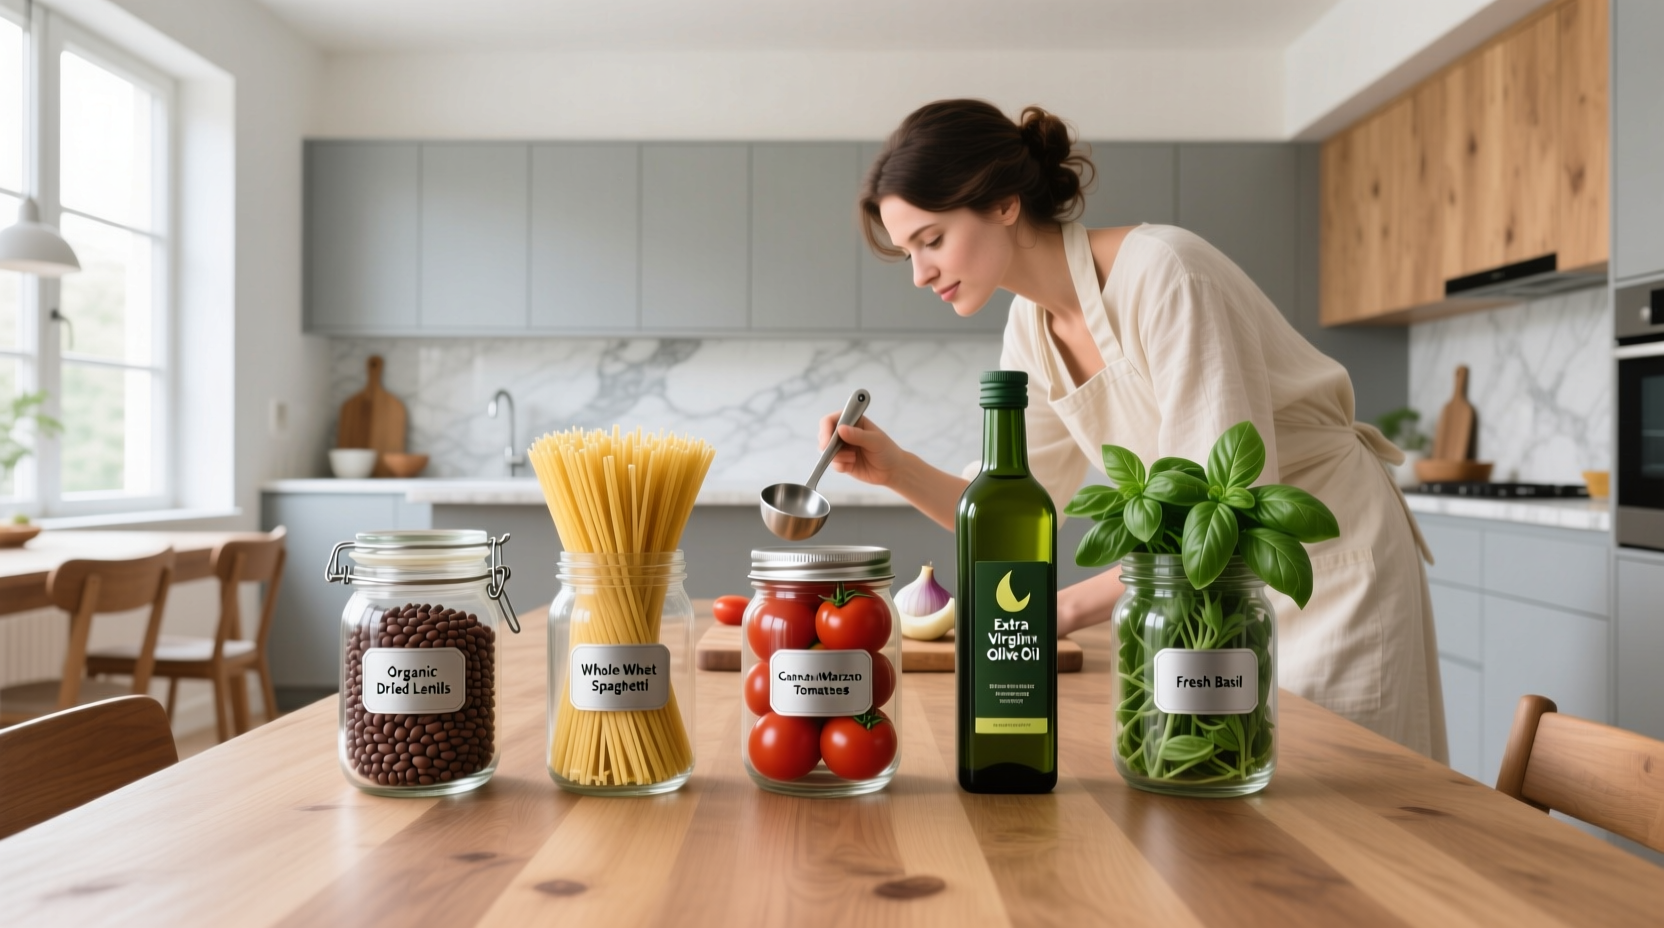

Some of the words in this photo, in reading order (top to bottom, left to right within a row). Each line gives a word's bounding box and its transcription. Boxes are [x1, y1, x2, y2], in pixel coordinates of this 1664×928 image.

[994, 618, 1029, 631] Extra
[1020, 647, 1040, 661] Oil
[387, 665, 438, 681] Organic
[581, 663, 620, 676] Whole
[591, 679, 649, 695] Spaghetti
[1176, 675, 1211, 688] Fresh
[1215, 675, 1243, 688] Basil
